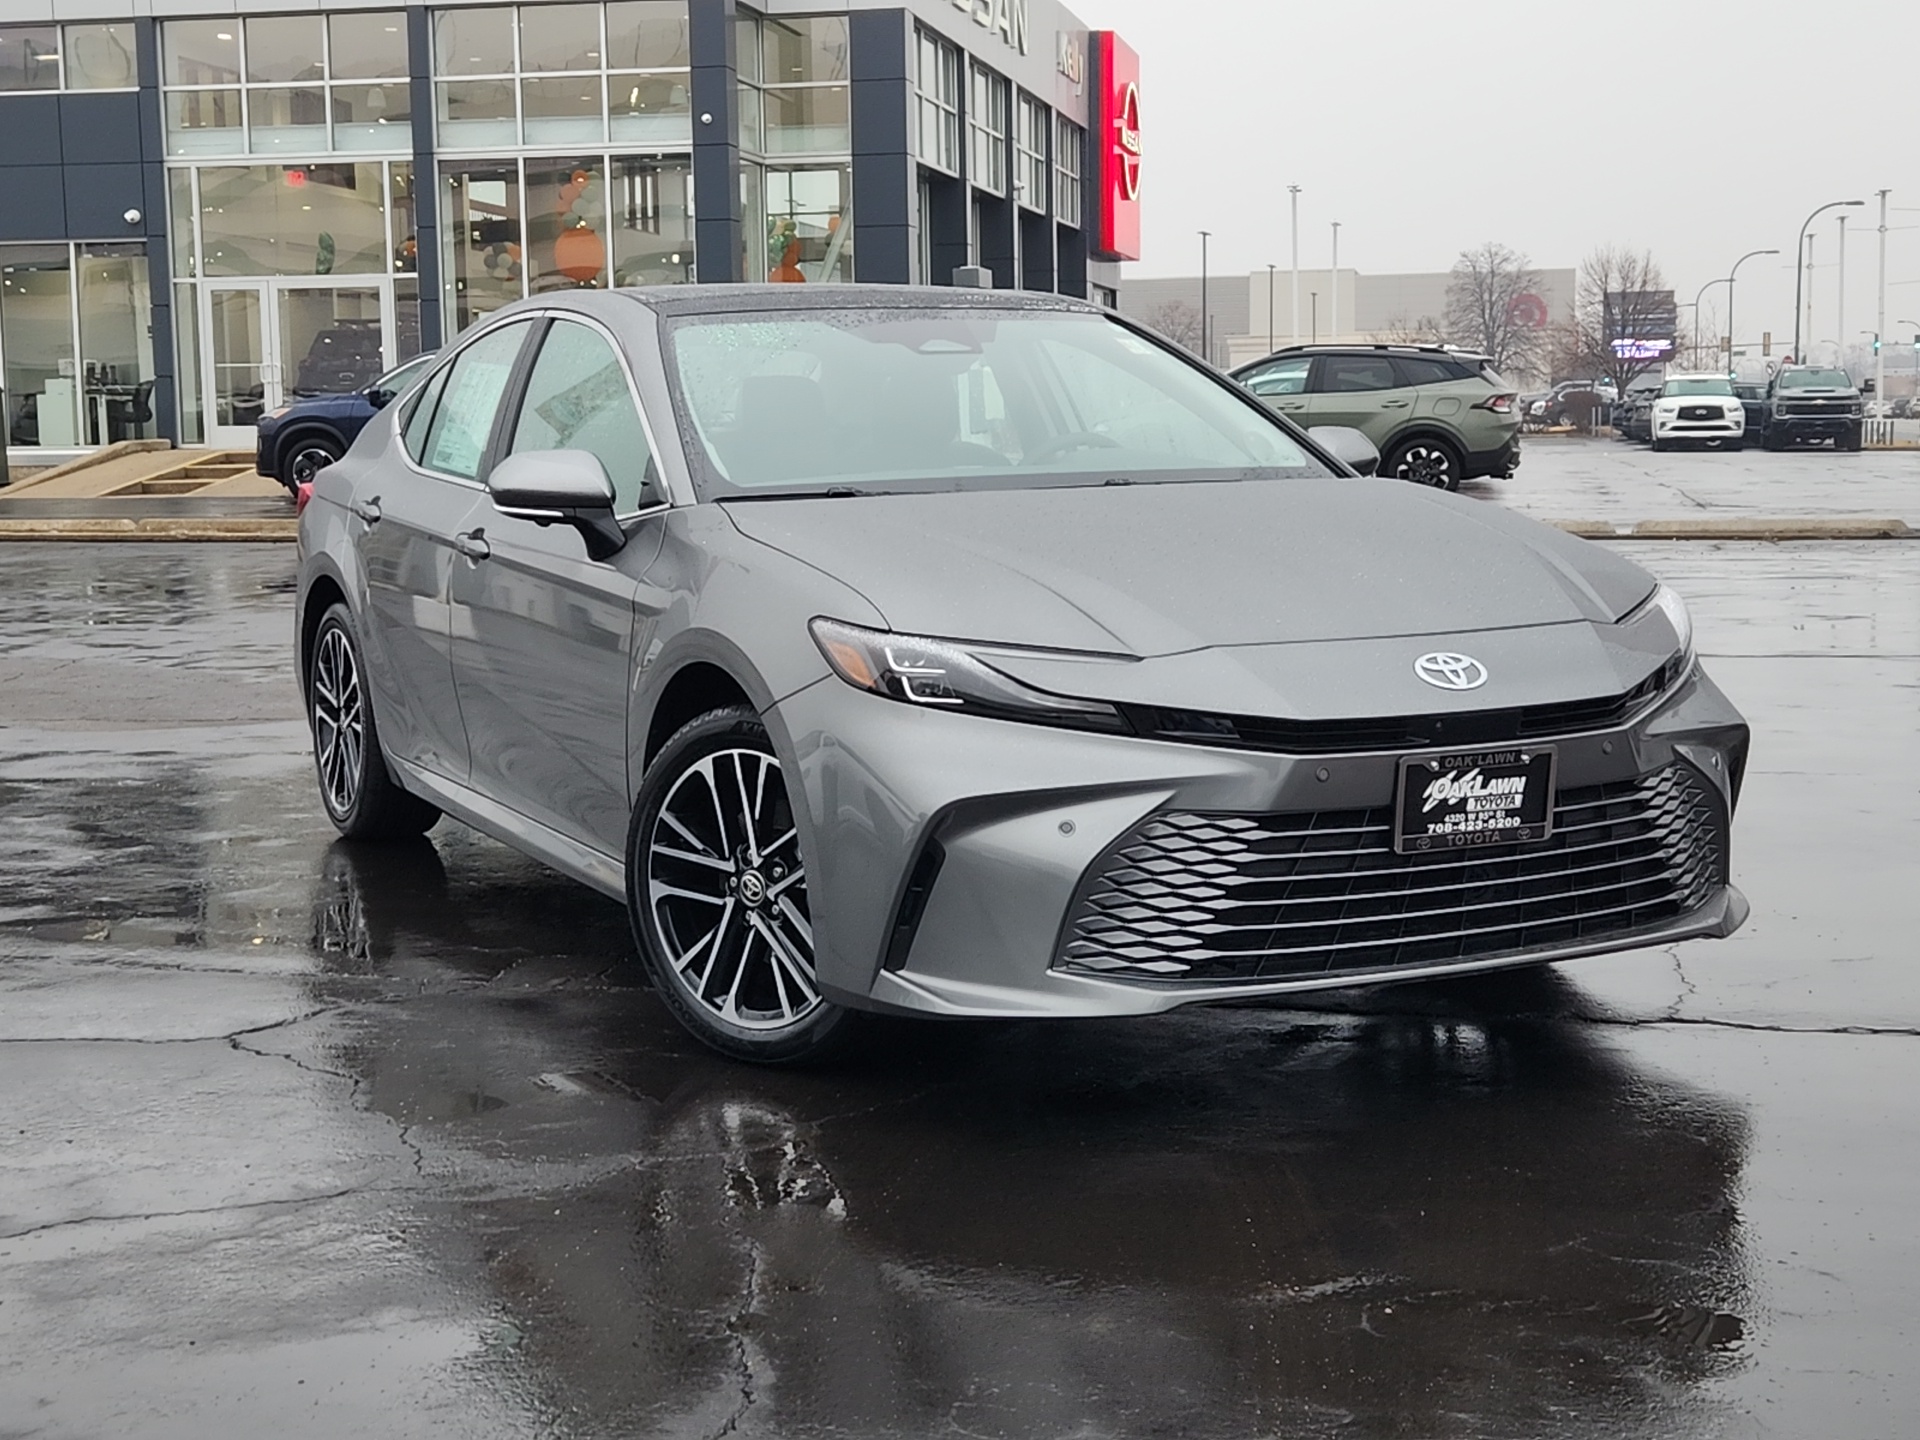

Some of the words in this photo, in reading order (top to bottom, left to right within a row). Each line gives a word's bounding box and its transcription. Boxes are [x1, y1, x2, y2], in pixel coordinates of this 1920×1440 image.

[1444, 756, 1473, 768] OAK
[1477, 752, 1516, 765] LAWN
[1473, 796, 1517, 808] TOYOTA
[1467, 812, 1476, 821] W
[1427, 817, 1521, 834] 708-423-5200
[1447, 831, 1502, 846] TOYOTA
